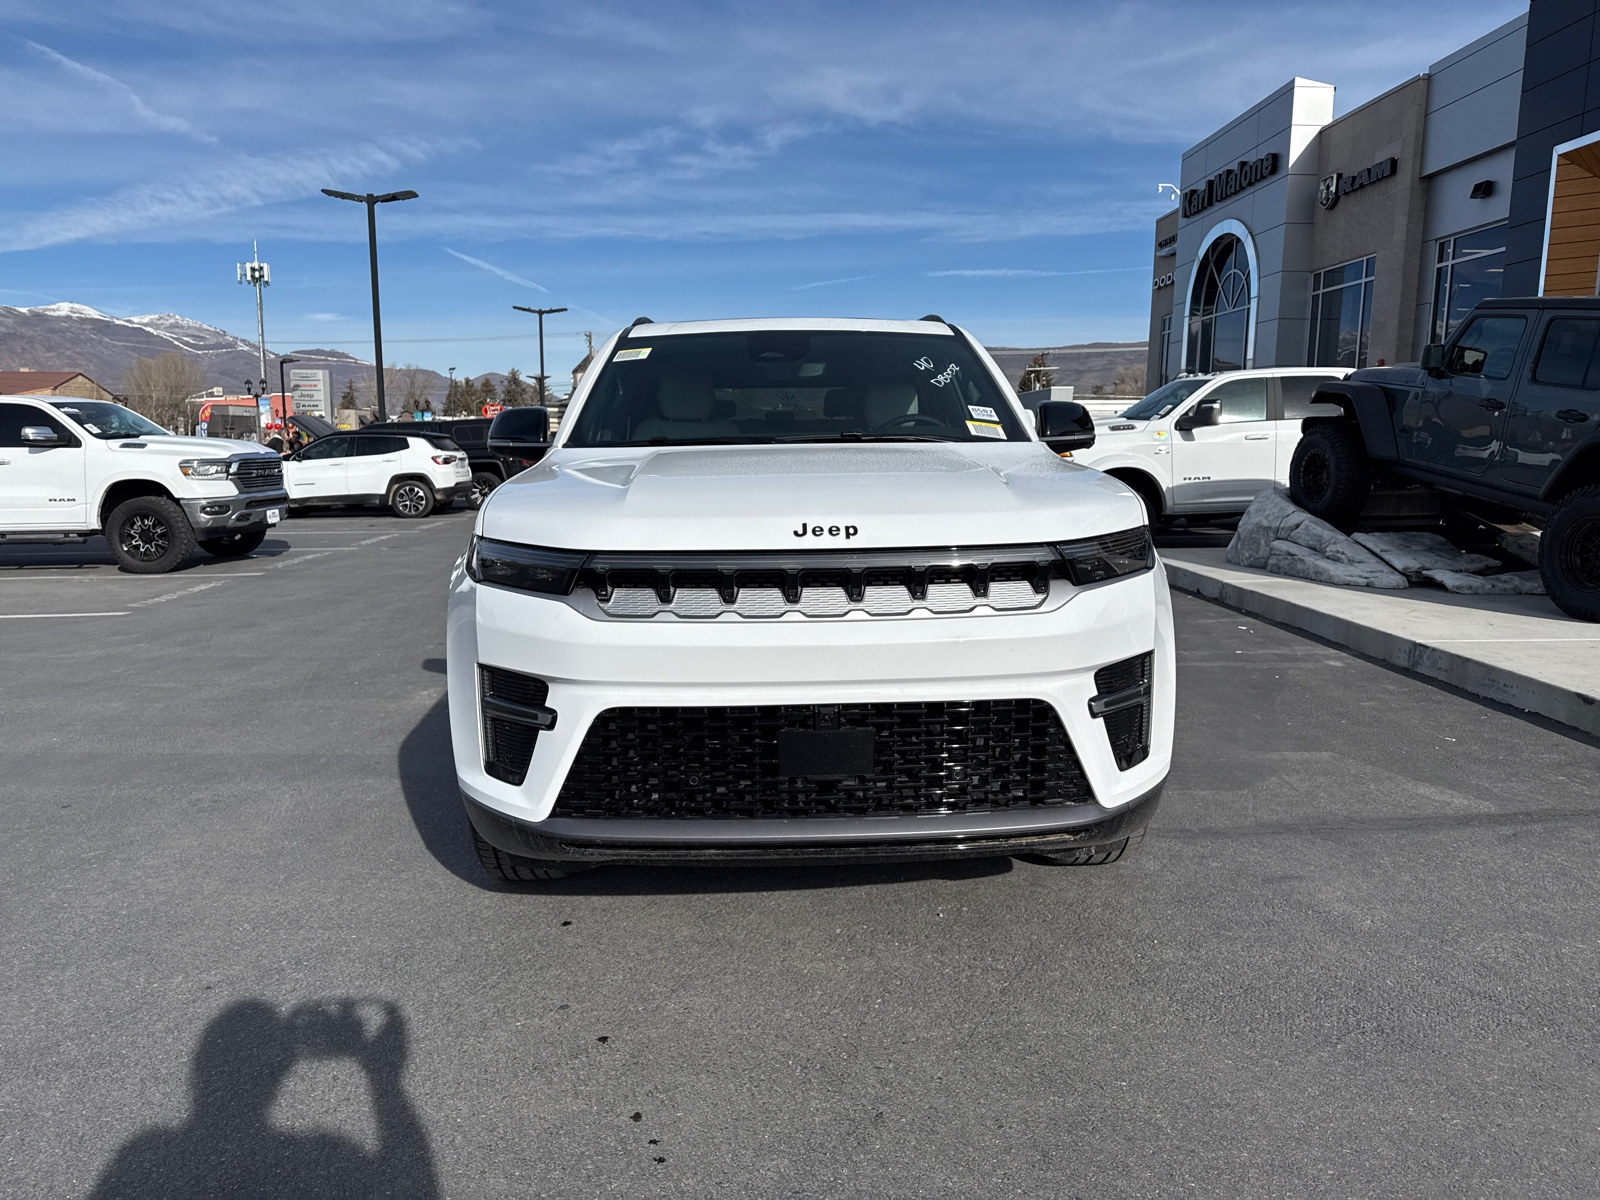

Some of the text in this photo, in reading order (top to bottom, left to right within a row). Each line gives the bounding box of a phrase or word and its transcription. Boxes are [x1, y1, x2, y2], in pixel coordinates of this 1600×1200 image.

[1182, 153, 1279, 218] Karl Malone
[1338, 157, 1398, 195] RAM
[1153, 272, 1176, 289] DOD
[793, 522, 858, 540] Jeep
